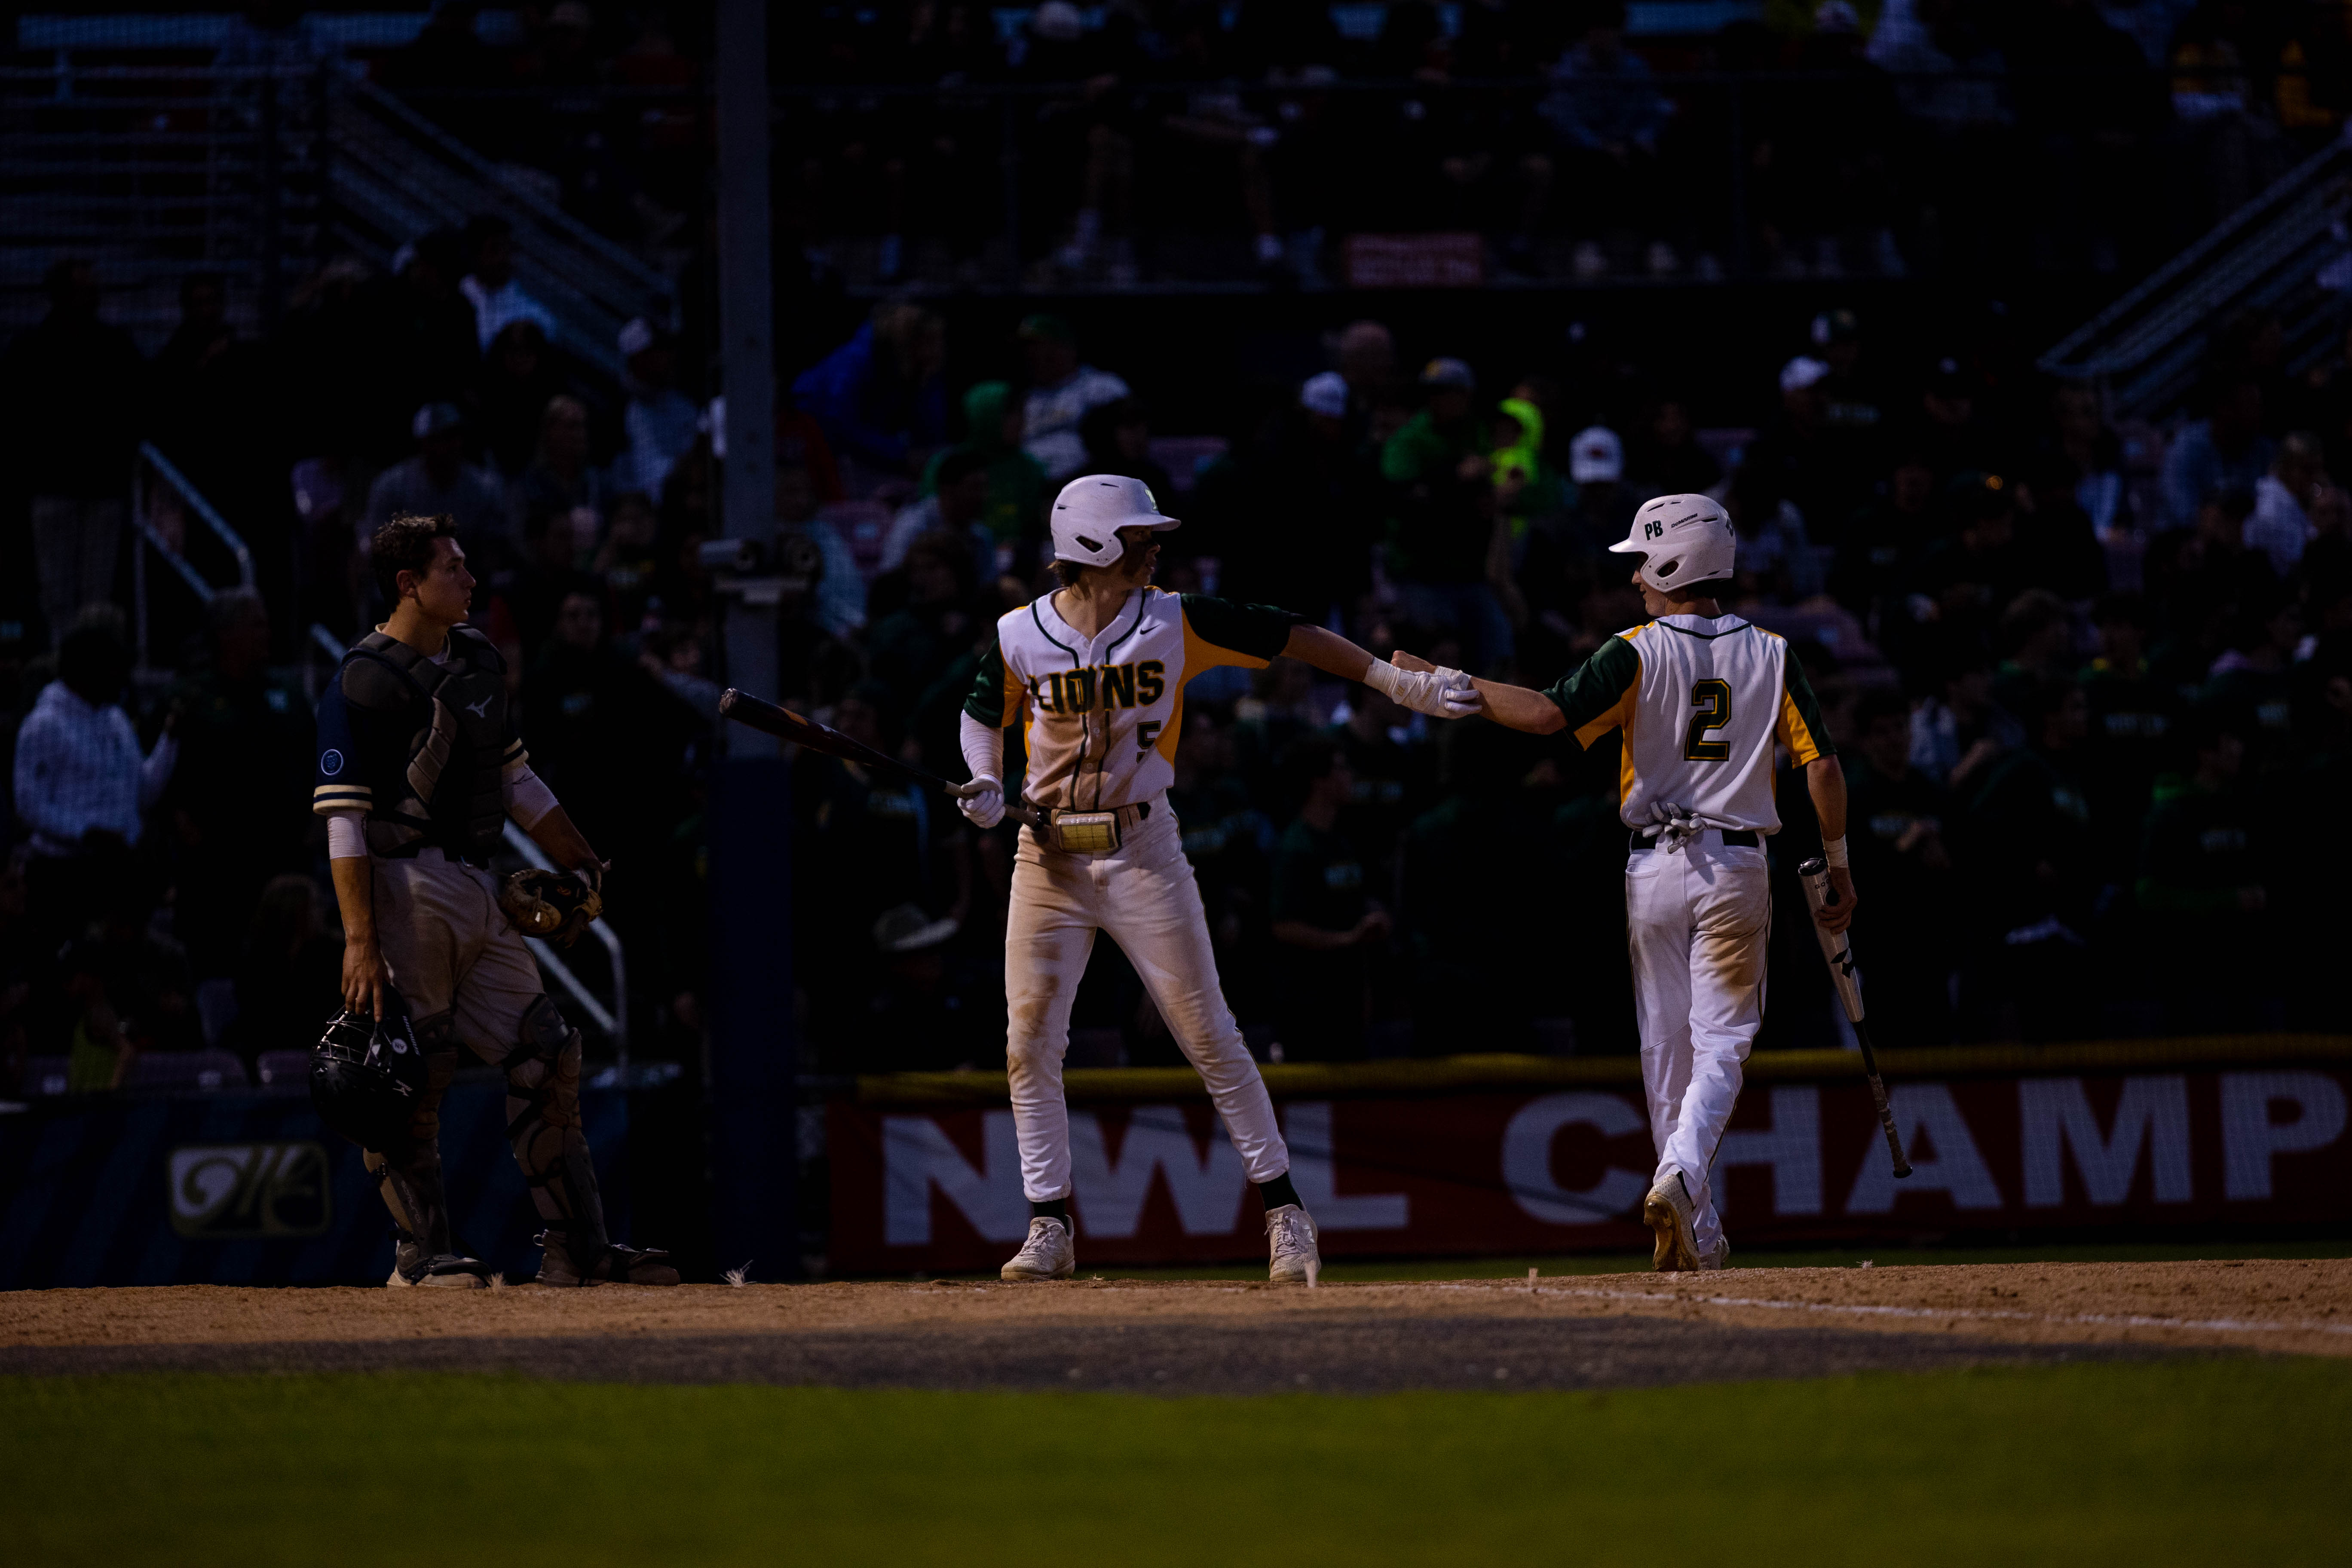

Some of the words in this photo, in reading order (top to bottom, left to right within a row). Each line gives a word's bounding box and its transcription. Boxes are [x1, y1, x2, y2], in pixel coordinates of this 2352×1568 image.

[1645, 520, 1663, 540] PB
[1029, 659, 1164, 714] LIONS
[1136, 720, 1161, 763] 5
[1684, 678, 1732, 761] 2
[880, 1099, 1412, 1248] NWL
[1498, 1069, 2351, 1228] CHAMP
